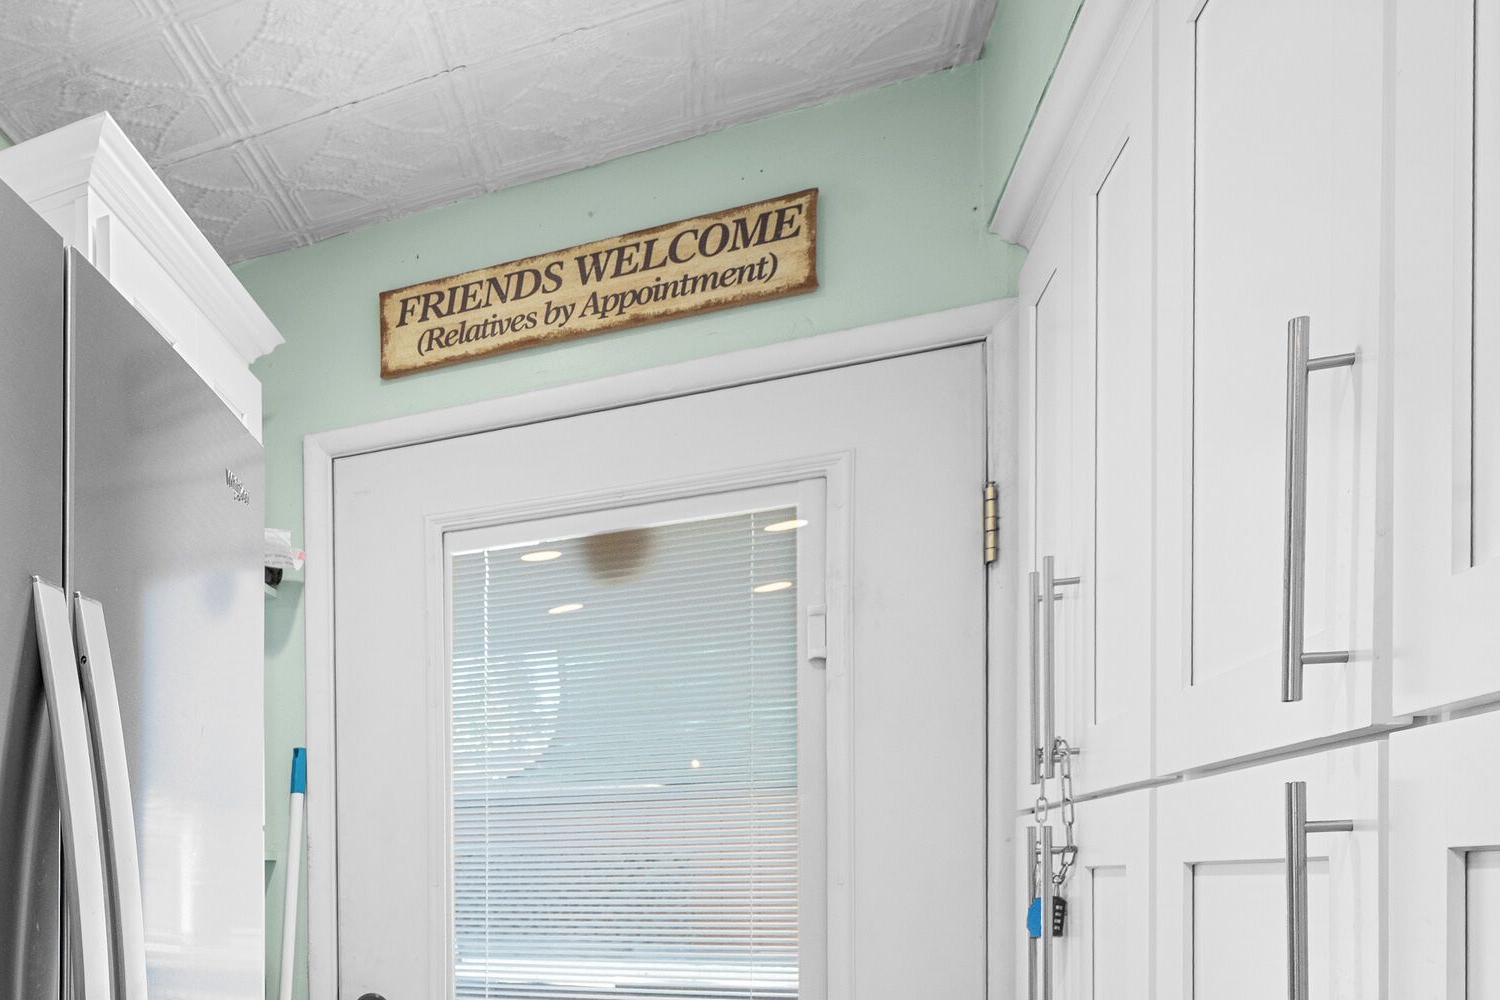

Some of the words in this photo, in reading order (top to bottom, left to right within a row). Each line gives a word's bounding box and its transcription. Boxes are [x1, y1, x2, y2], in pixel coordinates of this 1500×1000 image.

[395, 260, 565, 328] FRIENDS
[573, 203, 803, 287] WELCOME
[416, 308, 537, 357] (Relatives
[543, 299, 576, 327] by
[579, 252, 778, 320] Appointment)
